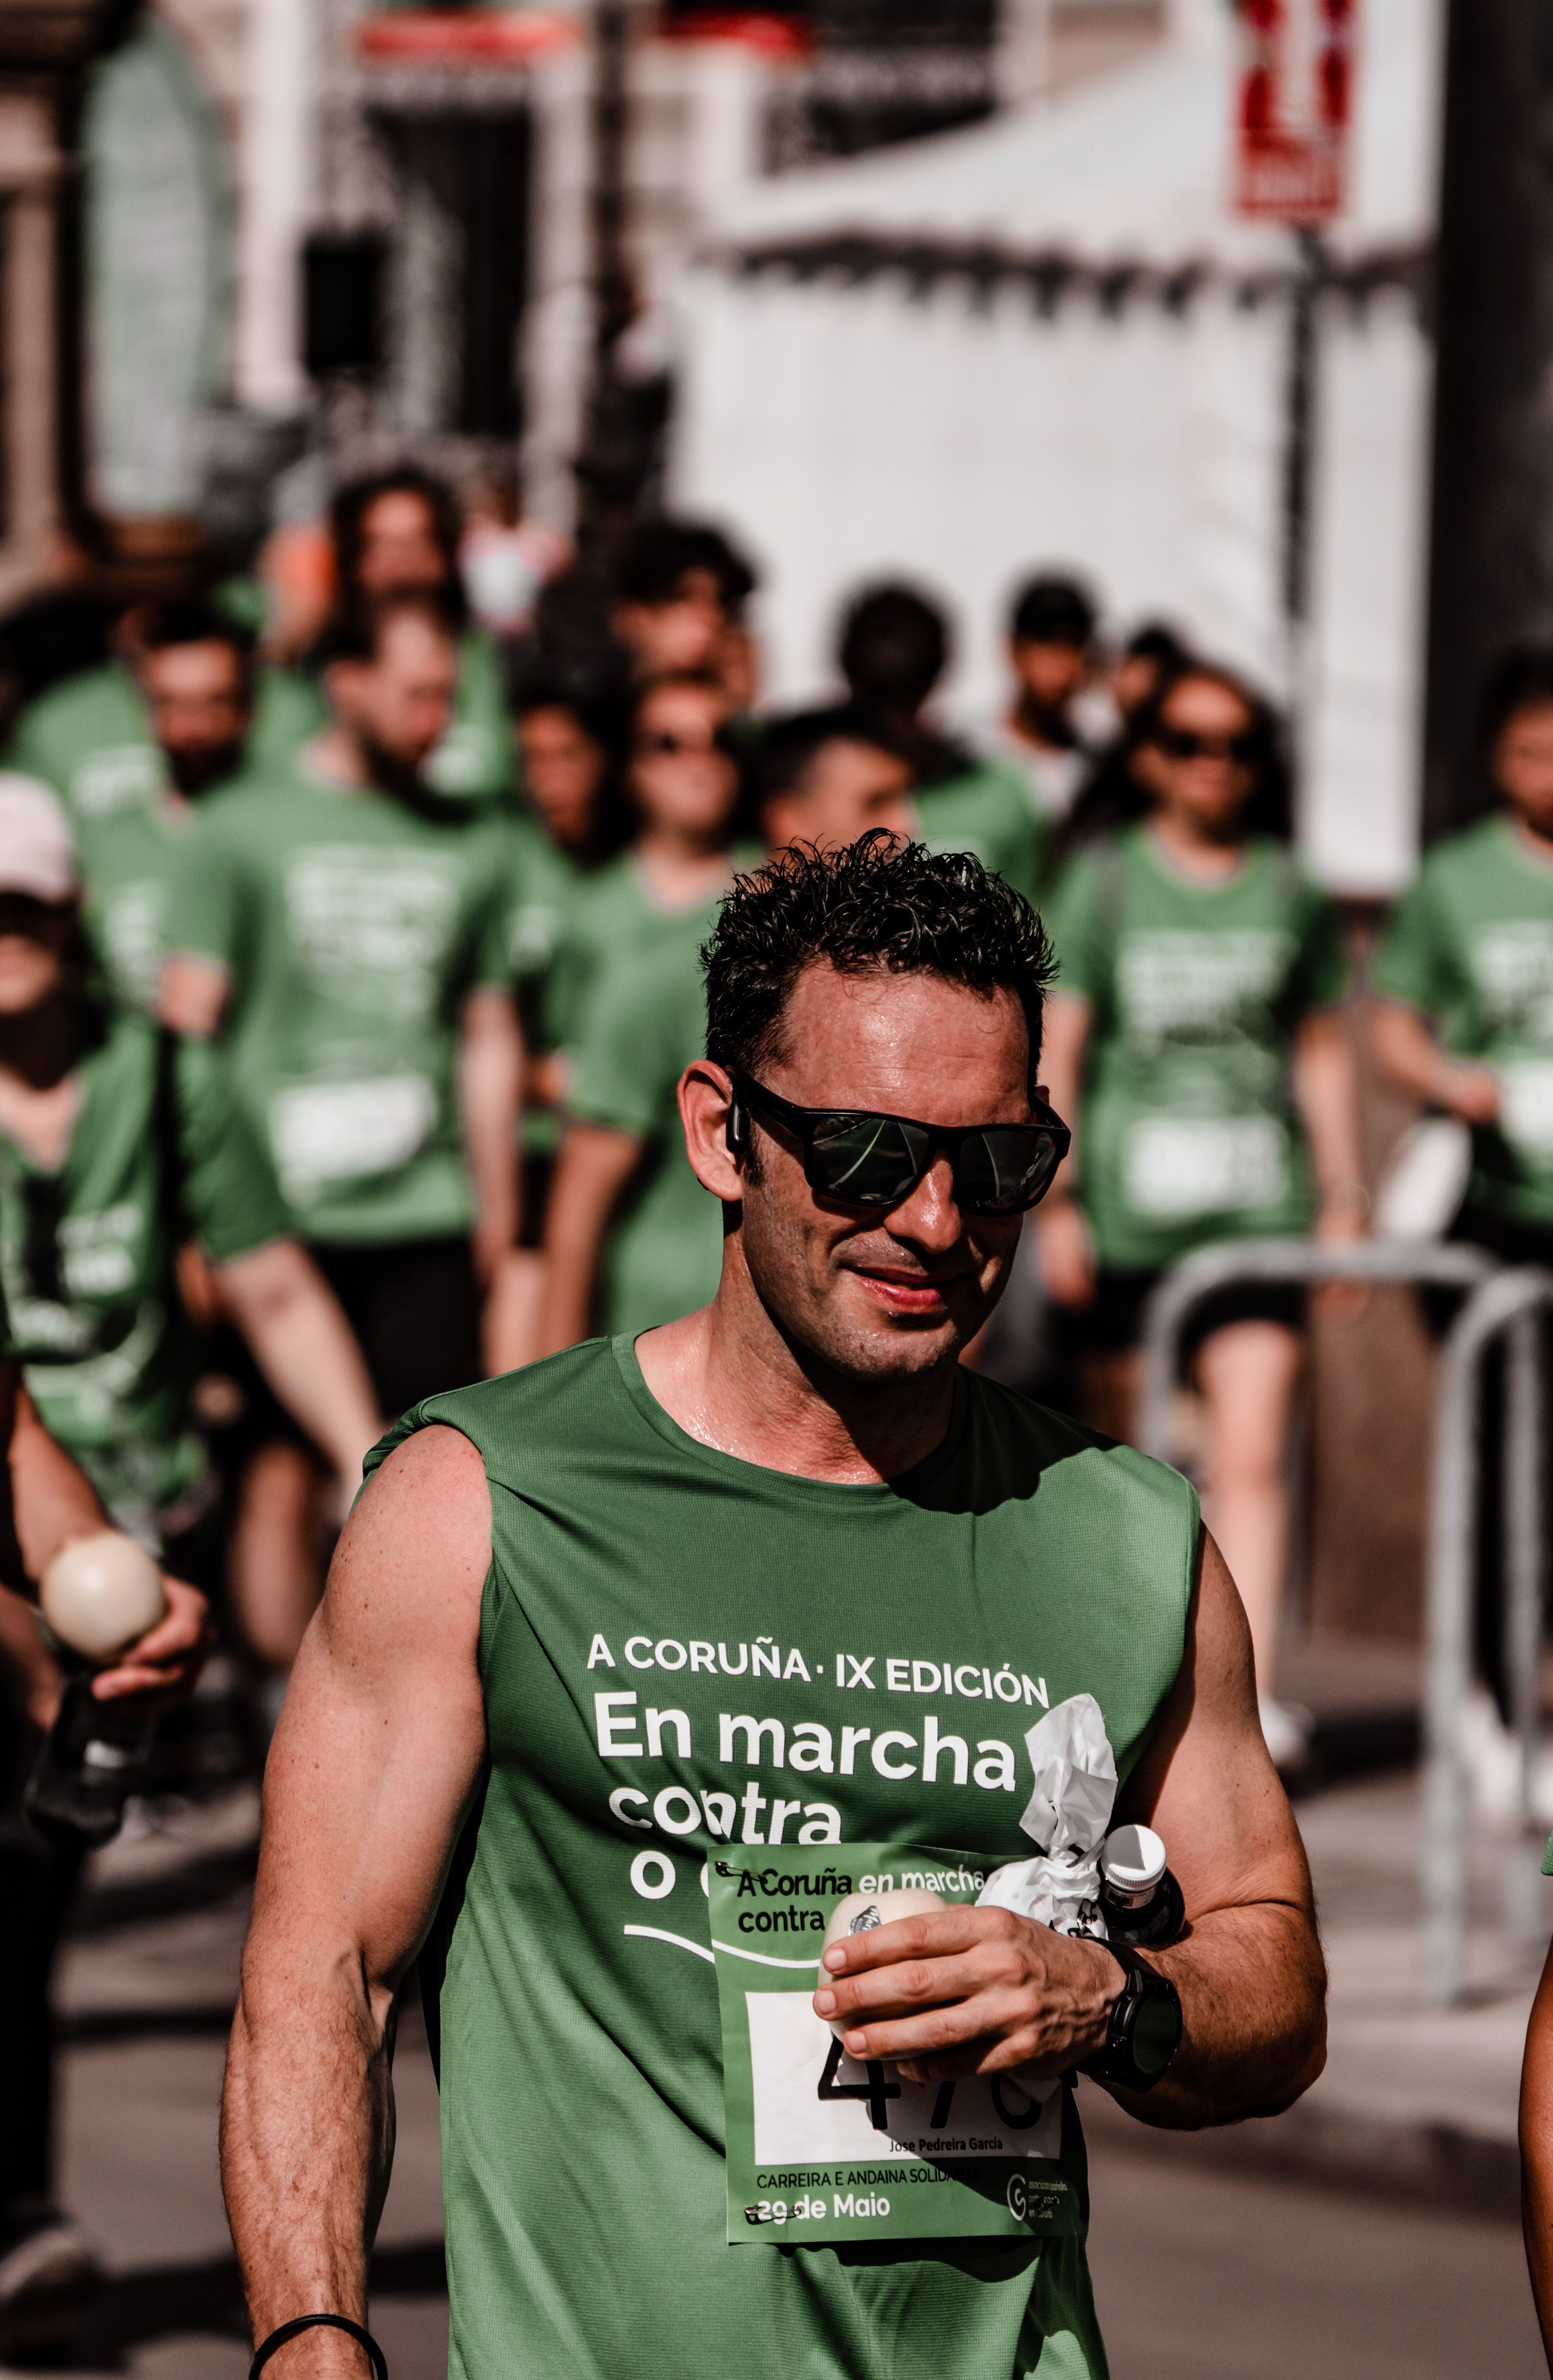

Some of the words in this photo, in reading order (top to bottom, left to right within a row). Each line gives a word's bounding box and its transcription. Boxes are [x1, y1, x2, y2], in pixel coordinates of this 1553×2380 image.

[587, 1634, 615, 1669] A
[837, 1654, 876, 1689] IX
[887, 1658, 1049, 1709] EDICIÓN
[594, 1691, 691, 1758] En
[719, 1713, 1016, 1792] marcha
[609, 1781, 842, 1845] contra
[630, 1850, 676, 1899] o
[737, 1869, 756, 1897] A
[759, 1868, 852, 1896] Coruña
[859, 1874, 894, 1894] en
[902, 1864, 985, 1892] marcha
[738, 1905, 825, 1933] contra
[890, 2140, 915, 2152] Jose
[919, 2138, 966, 2152] Pedreira
[969, 2136, 1003, 2150] García
[757, 2171, 831, 2189] CARREIRA
[835, 2171, 843, 2186] E
[847, 2170, 907, 2185] ANDAINA
[910, 2166, 981, 2183] SOLIDARIAS
[758, 2201, 787, 2225] 29
[795, 2195, 826, 2219] de
[833, 2192, 890, 2218] Maio
